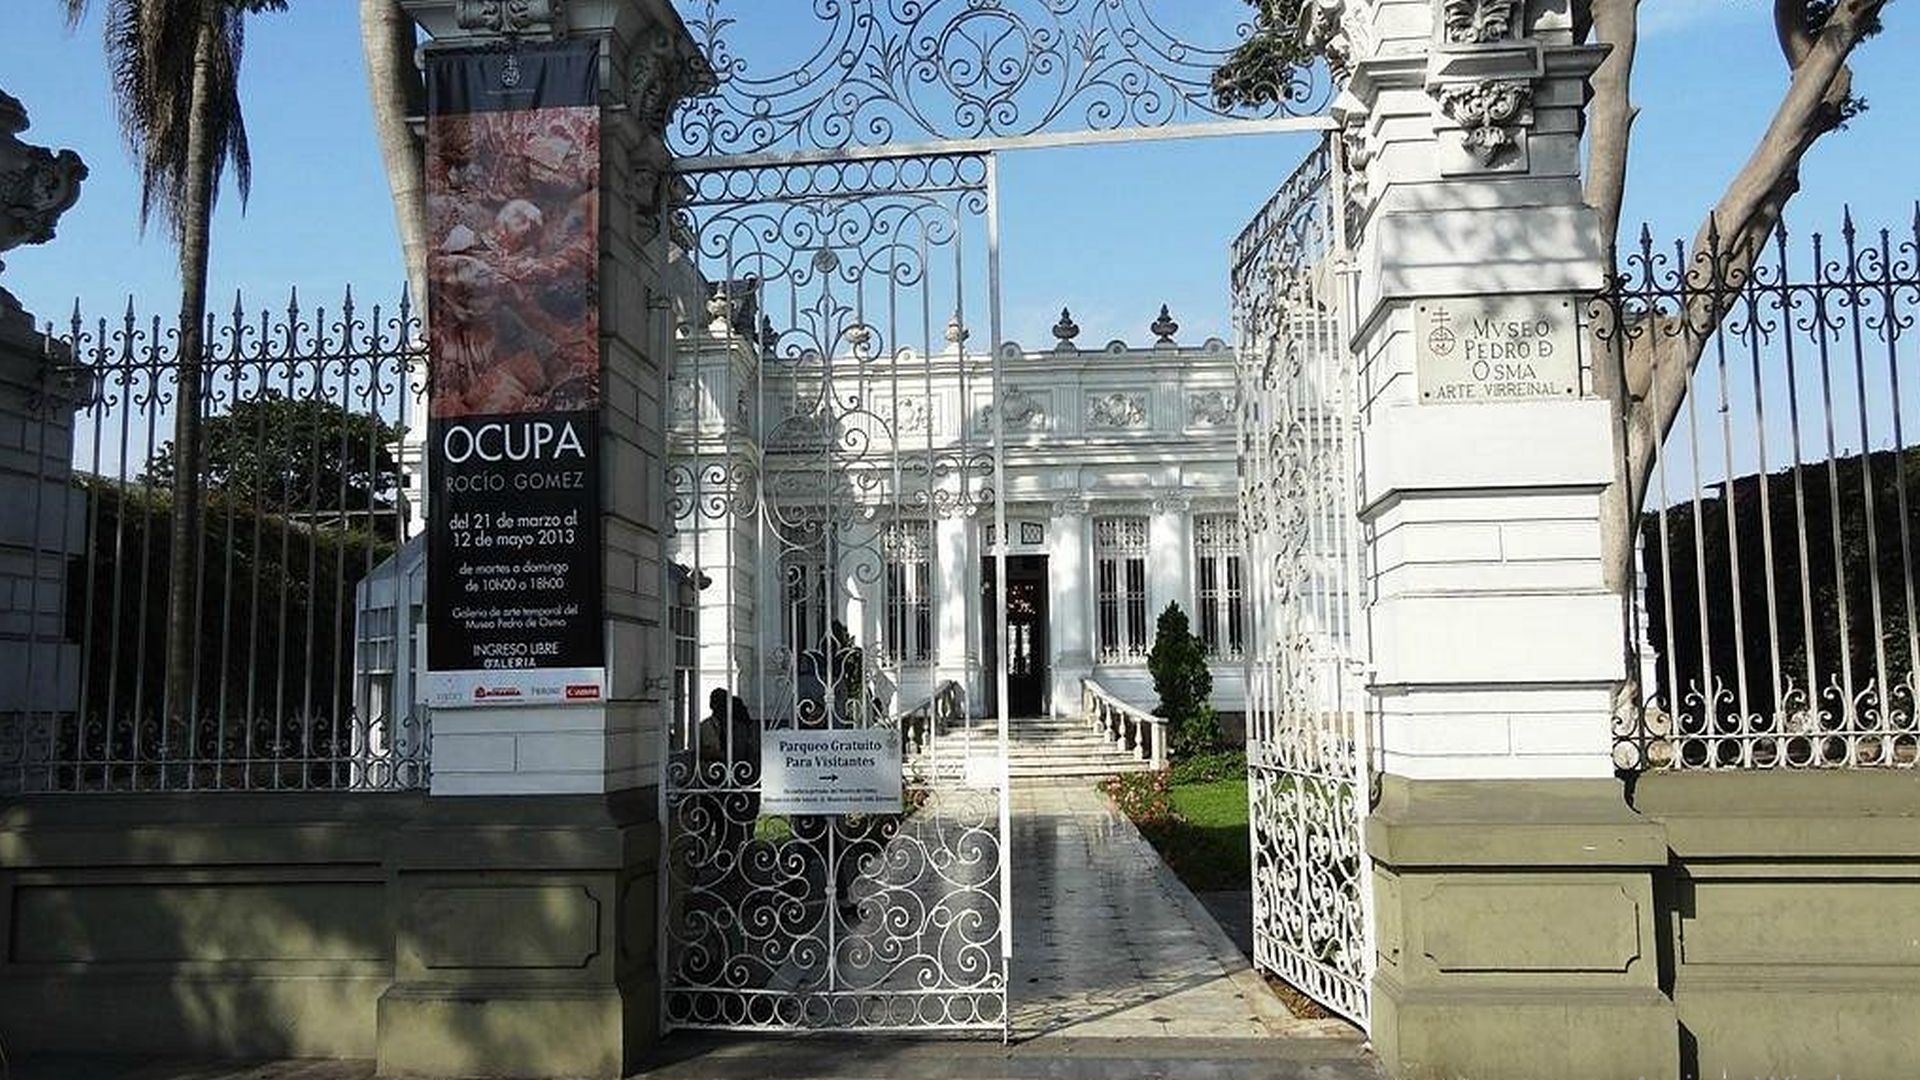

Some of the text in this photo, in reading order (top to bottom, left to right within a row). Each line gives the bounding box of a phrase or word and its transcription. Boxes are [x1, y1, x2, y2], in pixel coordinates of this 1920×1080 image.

[1464, 340, 1531, 360] PEDRO
[1472, 360, 1537, 381] OSMA
[1436, 382, 1561, 399] ARTE VIRREINAL
[444, 420, 586, 463] OCUPA
[446, 470, 584, 493] ROCÍO GOMEZ
[449, 508, 578, 530] del 21 de marzo al
[454, 529, 575, 549] 12 de mayo 2013
[459, 562, 472, 575] de
[475, 564, 511, 574] martes
[522, 561, 569, 576] domingo
[465, 579, 479, 592] de
[483, 578, 517, 591] 10h00
[564, 604, 579, 616] del
[473, 641, 560, 656] INGRESO LIBRE
[780, 739, 882, 754] Parqueo Gratuito
[785, 755, 875, 768] Para Visitantes
